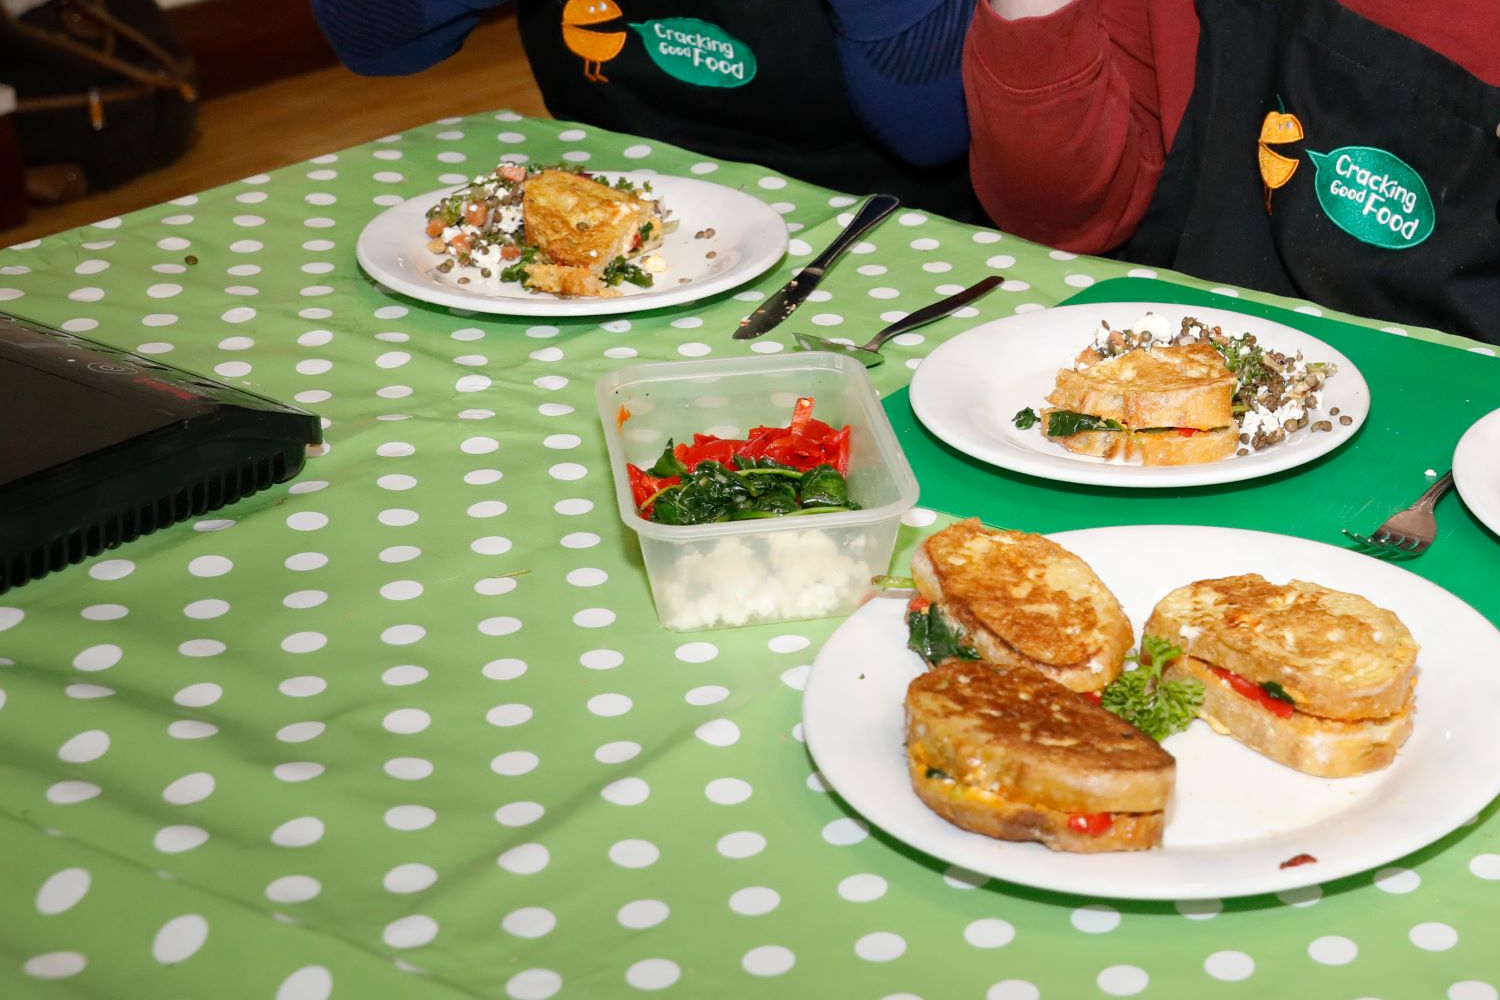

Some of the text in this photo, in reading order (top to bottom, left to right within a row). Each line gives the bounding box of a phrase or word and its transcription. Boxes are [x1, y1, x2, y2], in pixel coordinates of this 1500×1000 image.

[653, 23, 734, 59] Cracking
[659, 42, 744, 79] Good Food
[1335, 154, 1417, 213] Cracking
[1330, 180, 1419, 240] Good Food
